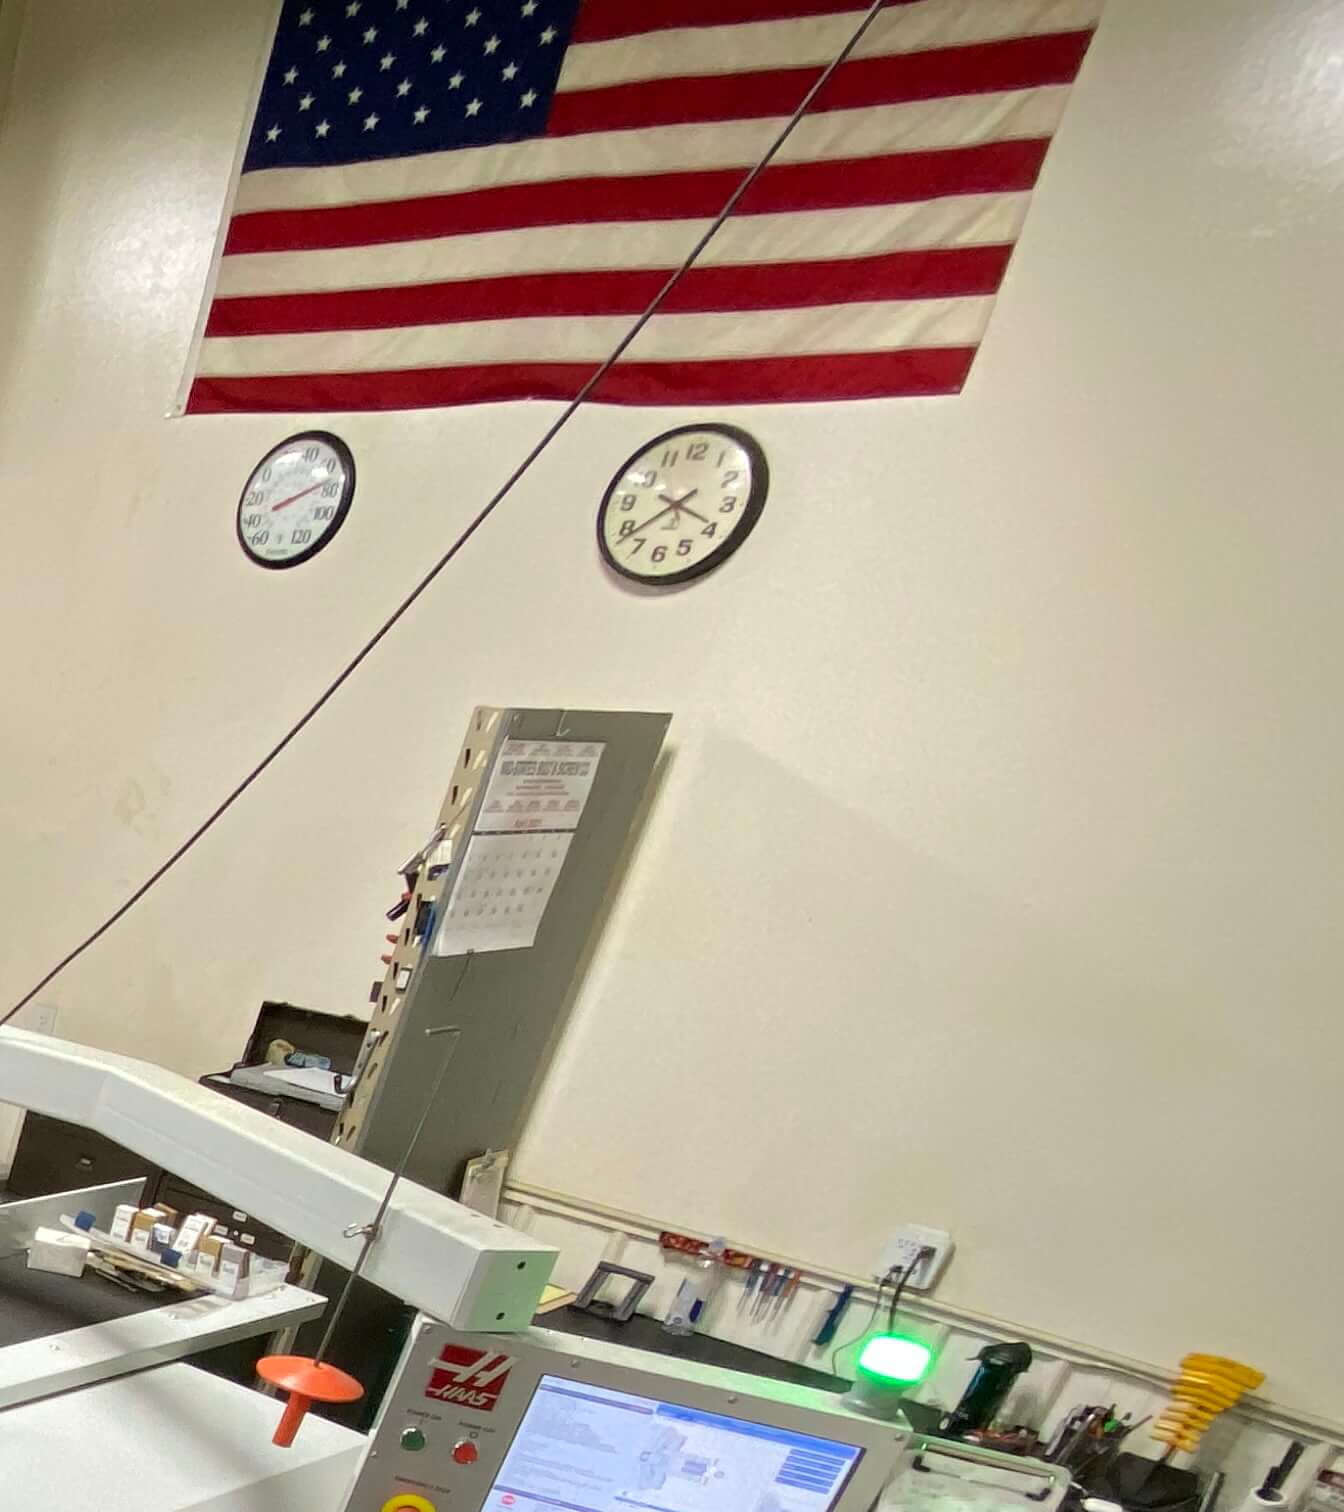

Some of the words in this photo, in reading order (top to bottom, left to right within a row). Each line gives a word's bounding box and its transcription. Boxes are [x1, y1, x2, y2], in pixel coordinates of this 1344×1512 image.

[302, 447, 320, 462] 40
[661, 451, 678, 467] 11
[686, 443, 709, 461] 12
[717, 452, 725, 468] 1
[262, 467, 272, 482] 0
[721, 471, 739, 489] 2
[321, 482, 339, 497] 80
[620, 494, 637, 511] 9
[719, 496, 737, 513] 3
[313, 506, 334, 520] 100
[619, 520, 636, 536] 8
[700, 522, 718, 538] 4
[291, 530, 312, 544] 120
[631, 538, 647, 554] 7
[676, 540, 694, 556] 5
[651, 546, 668, 563] 6
[427, 1384, 497, 1406] HAAS
